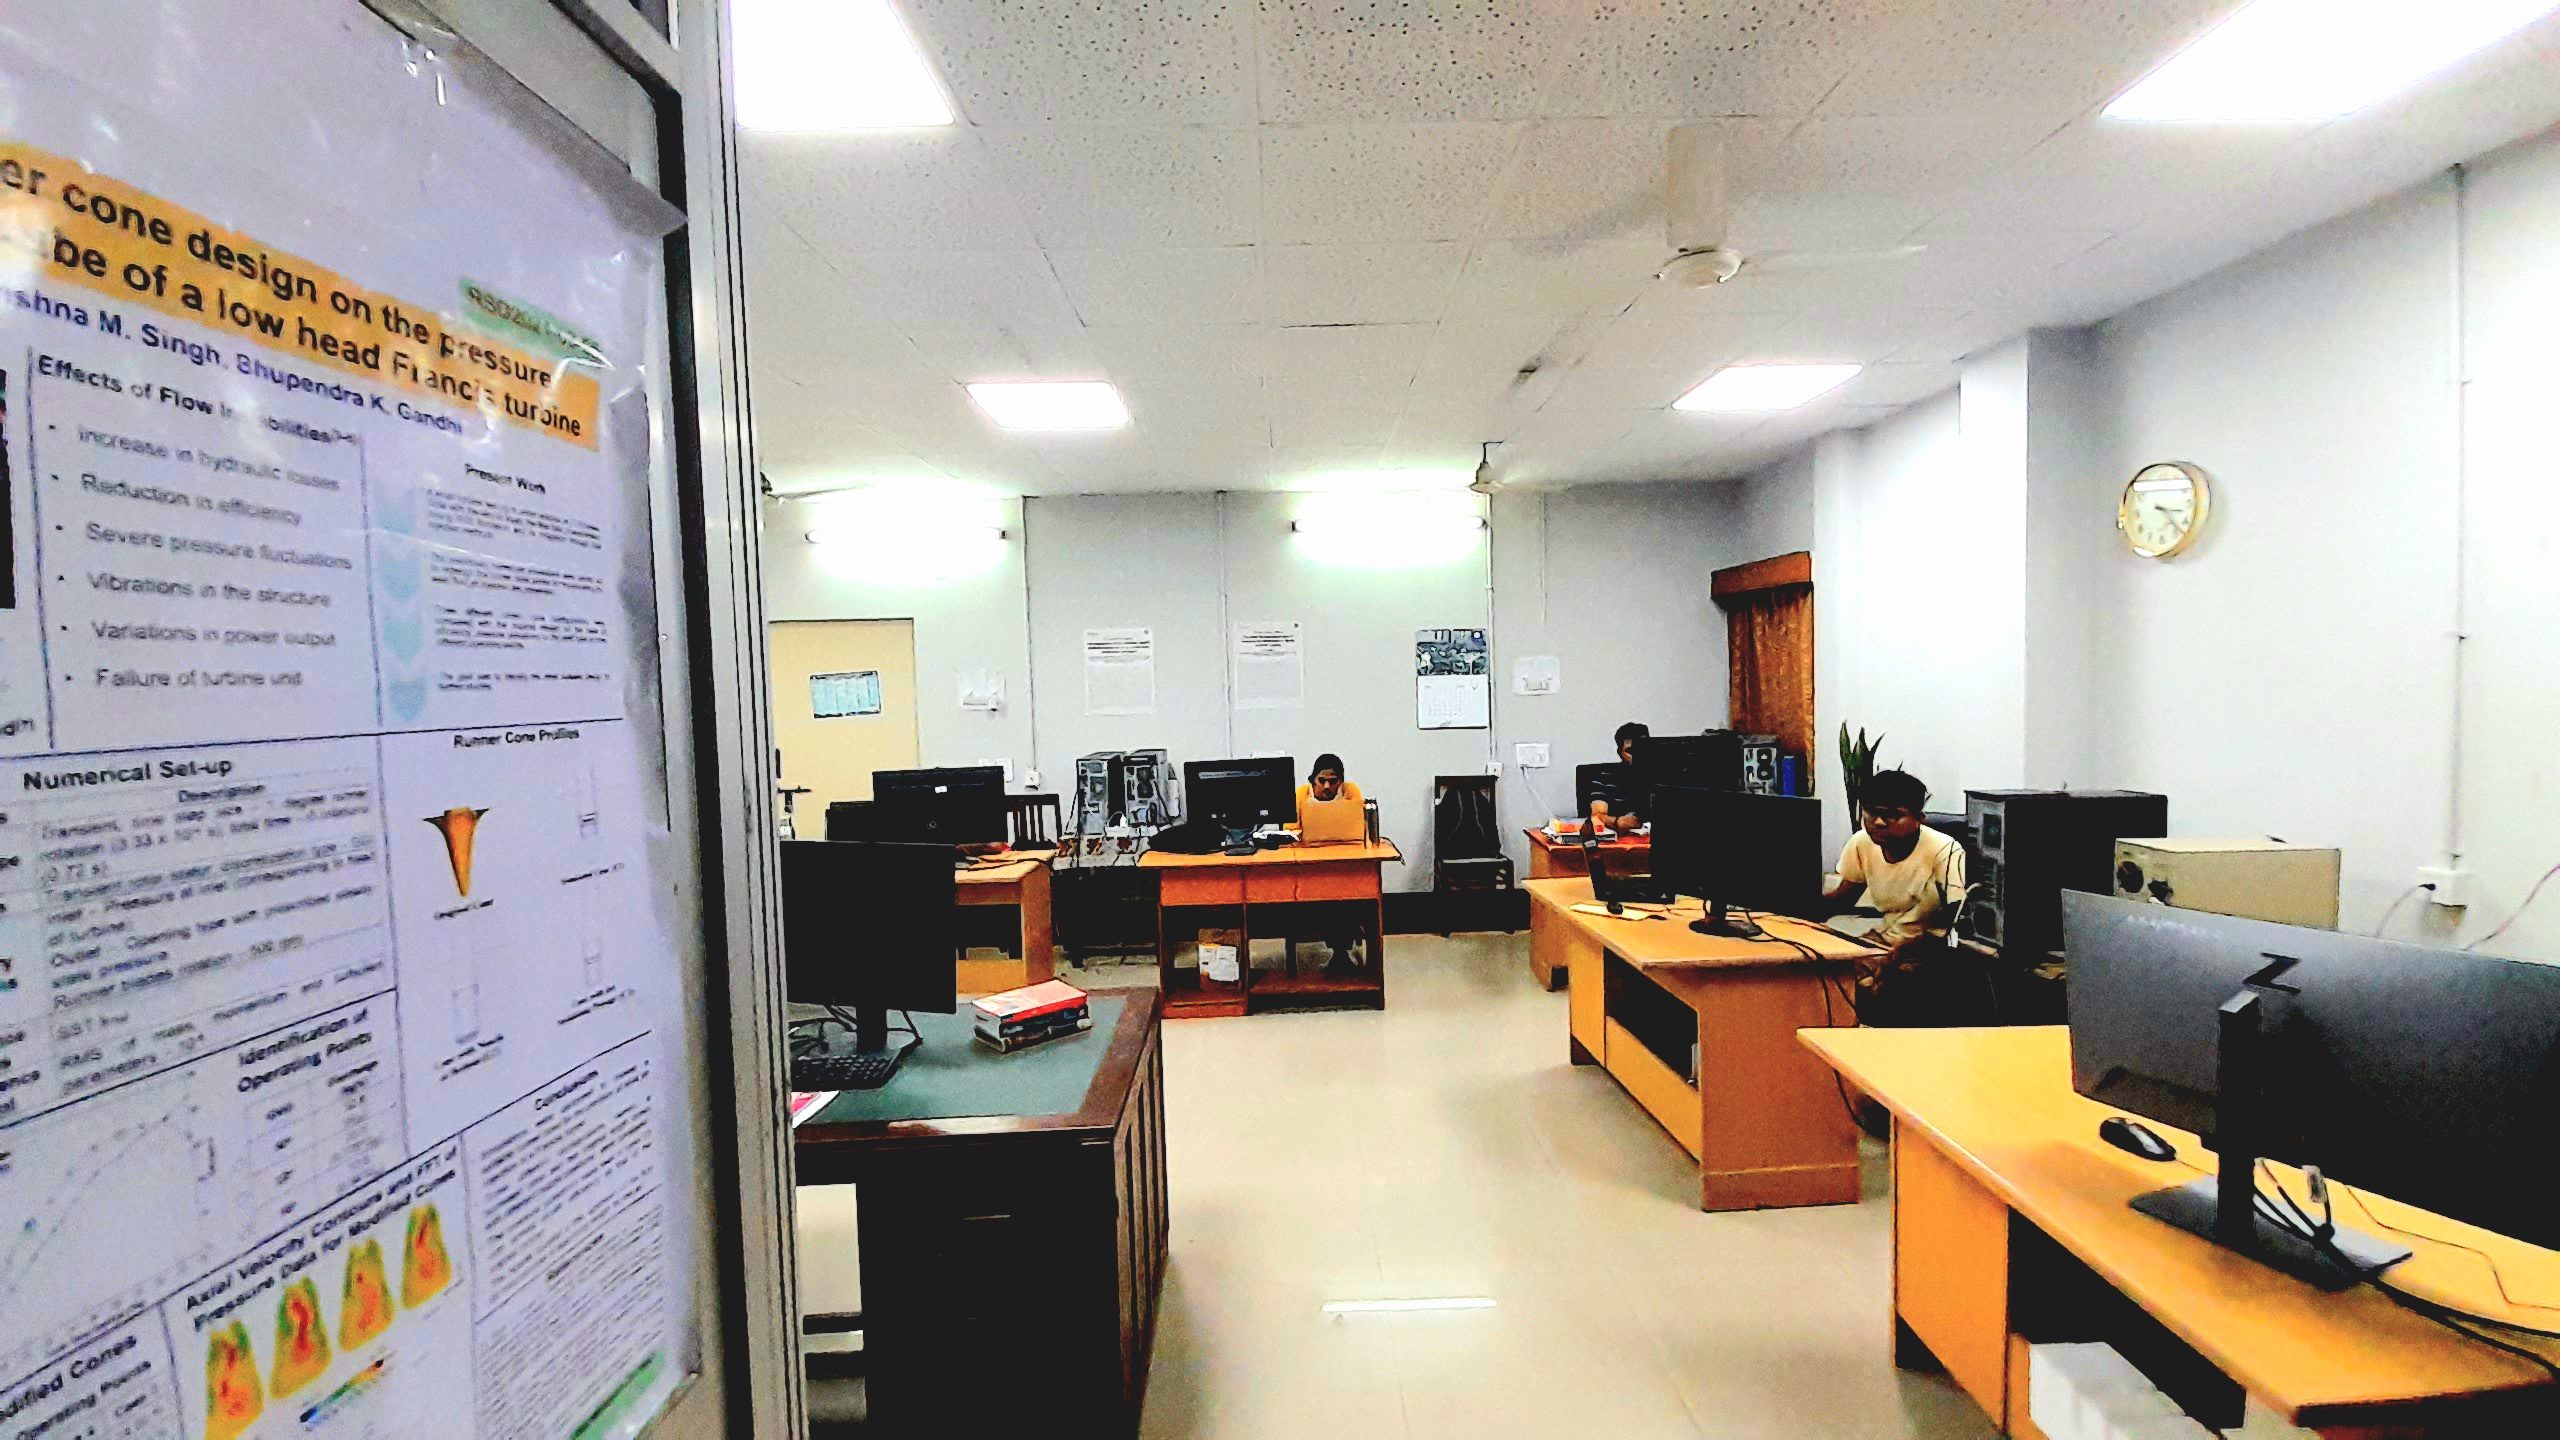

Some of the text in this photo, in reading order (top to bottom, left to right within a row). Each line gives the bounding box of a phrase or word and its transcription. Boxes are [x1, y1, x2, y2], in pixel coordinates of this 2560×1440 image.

[62, 183, 172, 246] cone
[187, 229, 317, 303] design
[330, 290, 372, 324] on
[382, 305, 429, 345] the
[440, 332, 552, 388] pressure
[45, 228, 107, 278] be
[123, 262, 168, 297] of
[181, 283, 203, 312] a
[217, 287, 284, 338] low
[298, 316, 380, 370] head
[504, 391, 581, 437] turbine
[8, 290, 89, 327] shna
[99, 310, 131, 340] M.
[236, 353, 364, 407] Bhupendra
[397, 402, 463, 434] Gandhi
[38, 354, 122, 394] Effects
[131, 383, 151, 400] of
[160, 386, 213, 415] Flow
[79, 424, 167, 459] Increase
[81, 473, 190, 508] Reduction
[196, 497, 214, 512] in
[86, 521, 163, 548] Severe
[170, 536, 255, 561] pressure
[86, 571, 331, 608] Vibrations in the structure
[91, 620, 197, 643] Variations
[202, 629, 220, 642] in
[224, 630, 280, 645] power
[95, 667, 171, 687] Failure
[177, 669, 197, 687] of
[201, 669, 266, 688] turbine
[453, 734, 502, 749] Runner
[505, 731, 536, 744] Cone
[22, 759, 233, 791] Numerical Set-up
[237, 1051, 322, 1093] Operating
[325, 1031, 373, 1057] Points
[238, 1017, 349, 1067] Identification
[187, 1272, 232, 1311] Axial
[237, 1236, 305, 1280] Velocity
[69, 1334, 137, 1379] Cones
